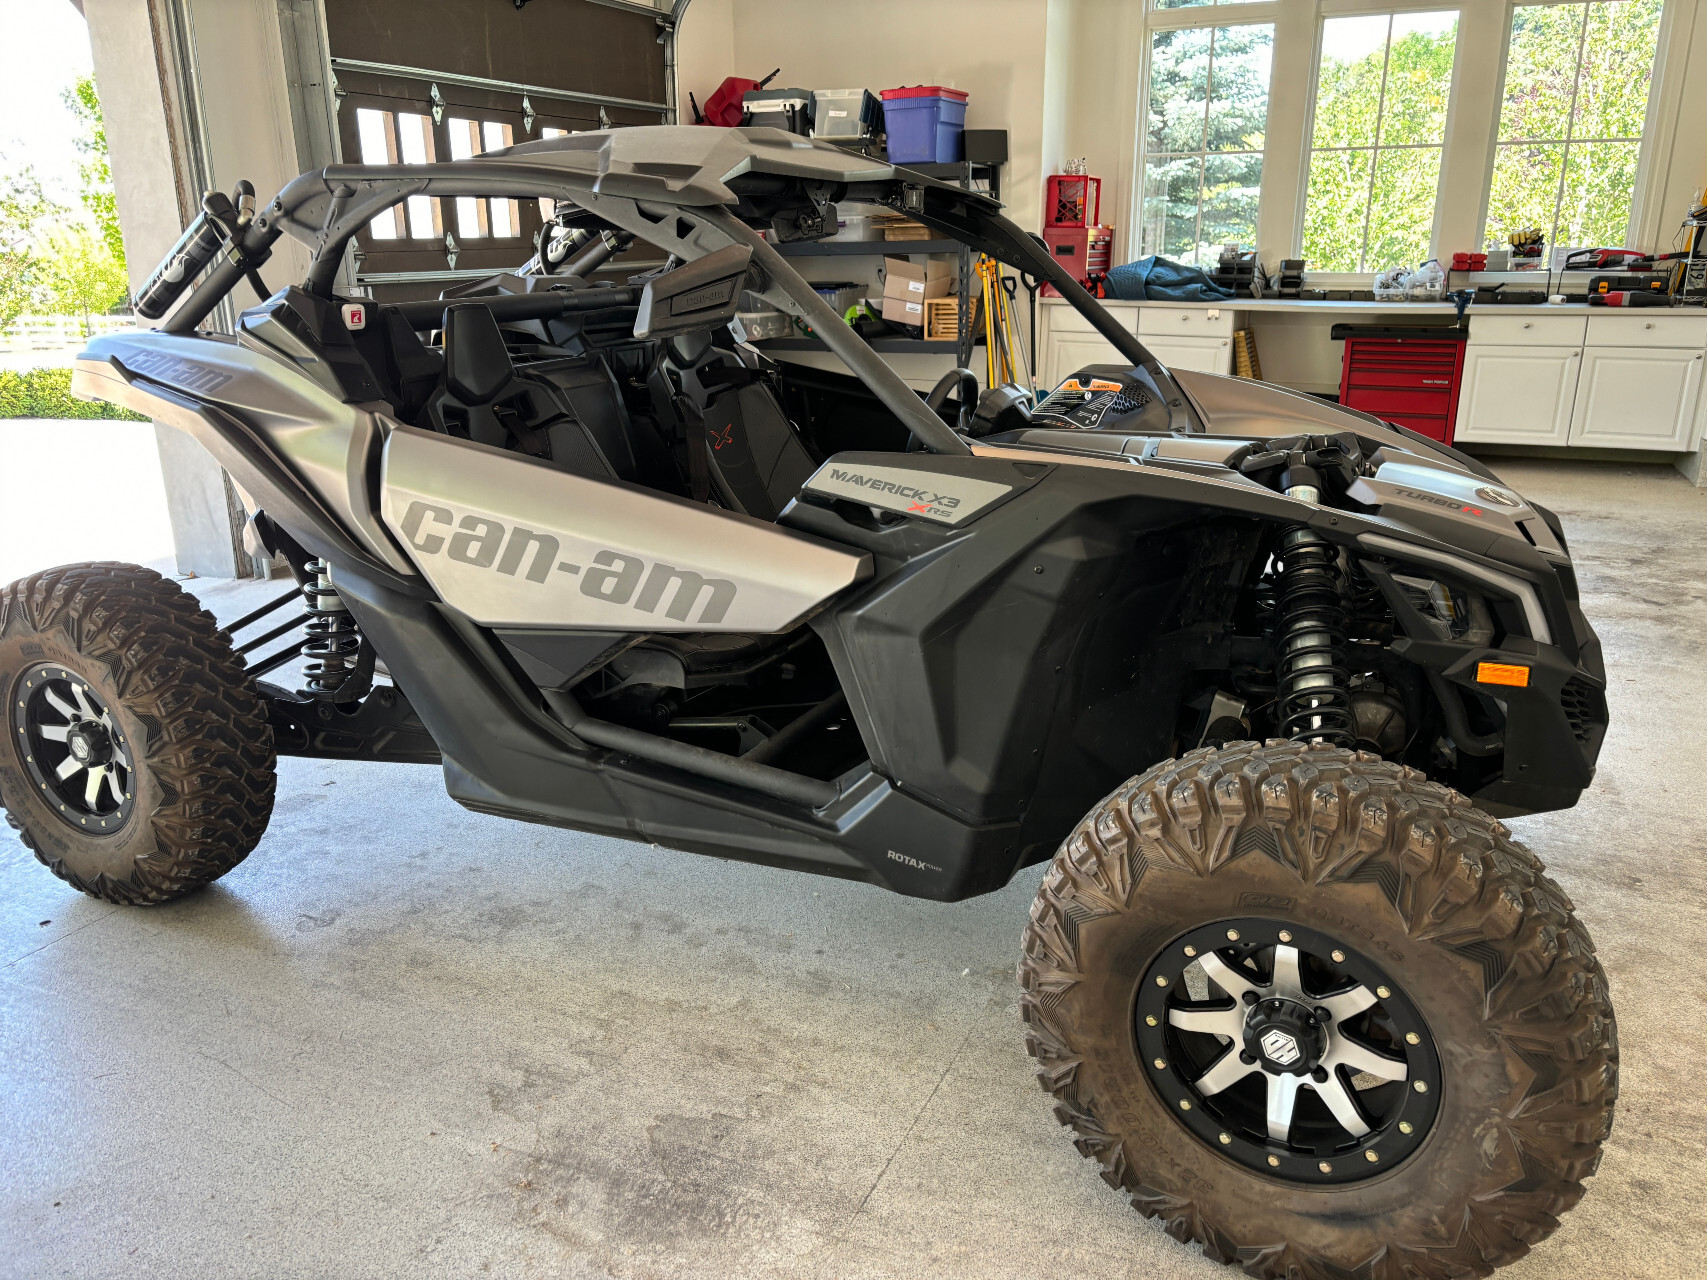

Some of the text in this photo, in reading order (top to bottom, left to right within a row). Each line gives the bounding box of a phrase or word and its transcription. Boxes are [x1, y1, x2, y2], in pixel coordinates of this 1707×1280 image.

[829, 468, 961, 509] MAVERICK X3
[400, 500, 738, 624] can-am
[887, 849, 926, 871] ROTAX
